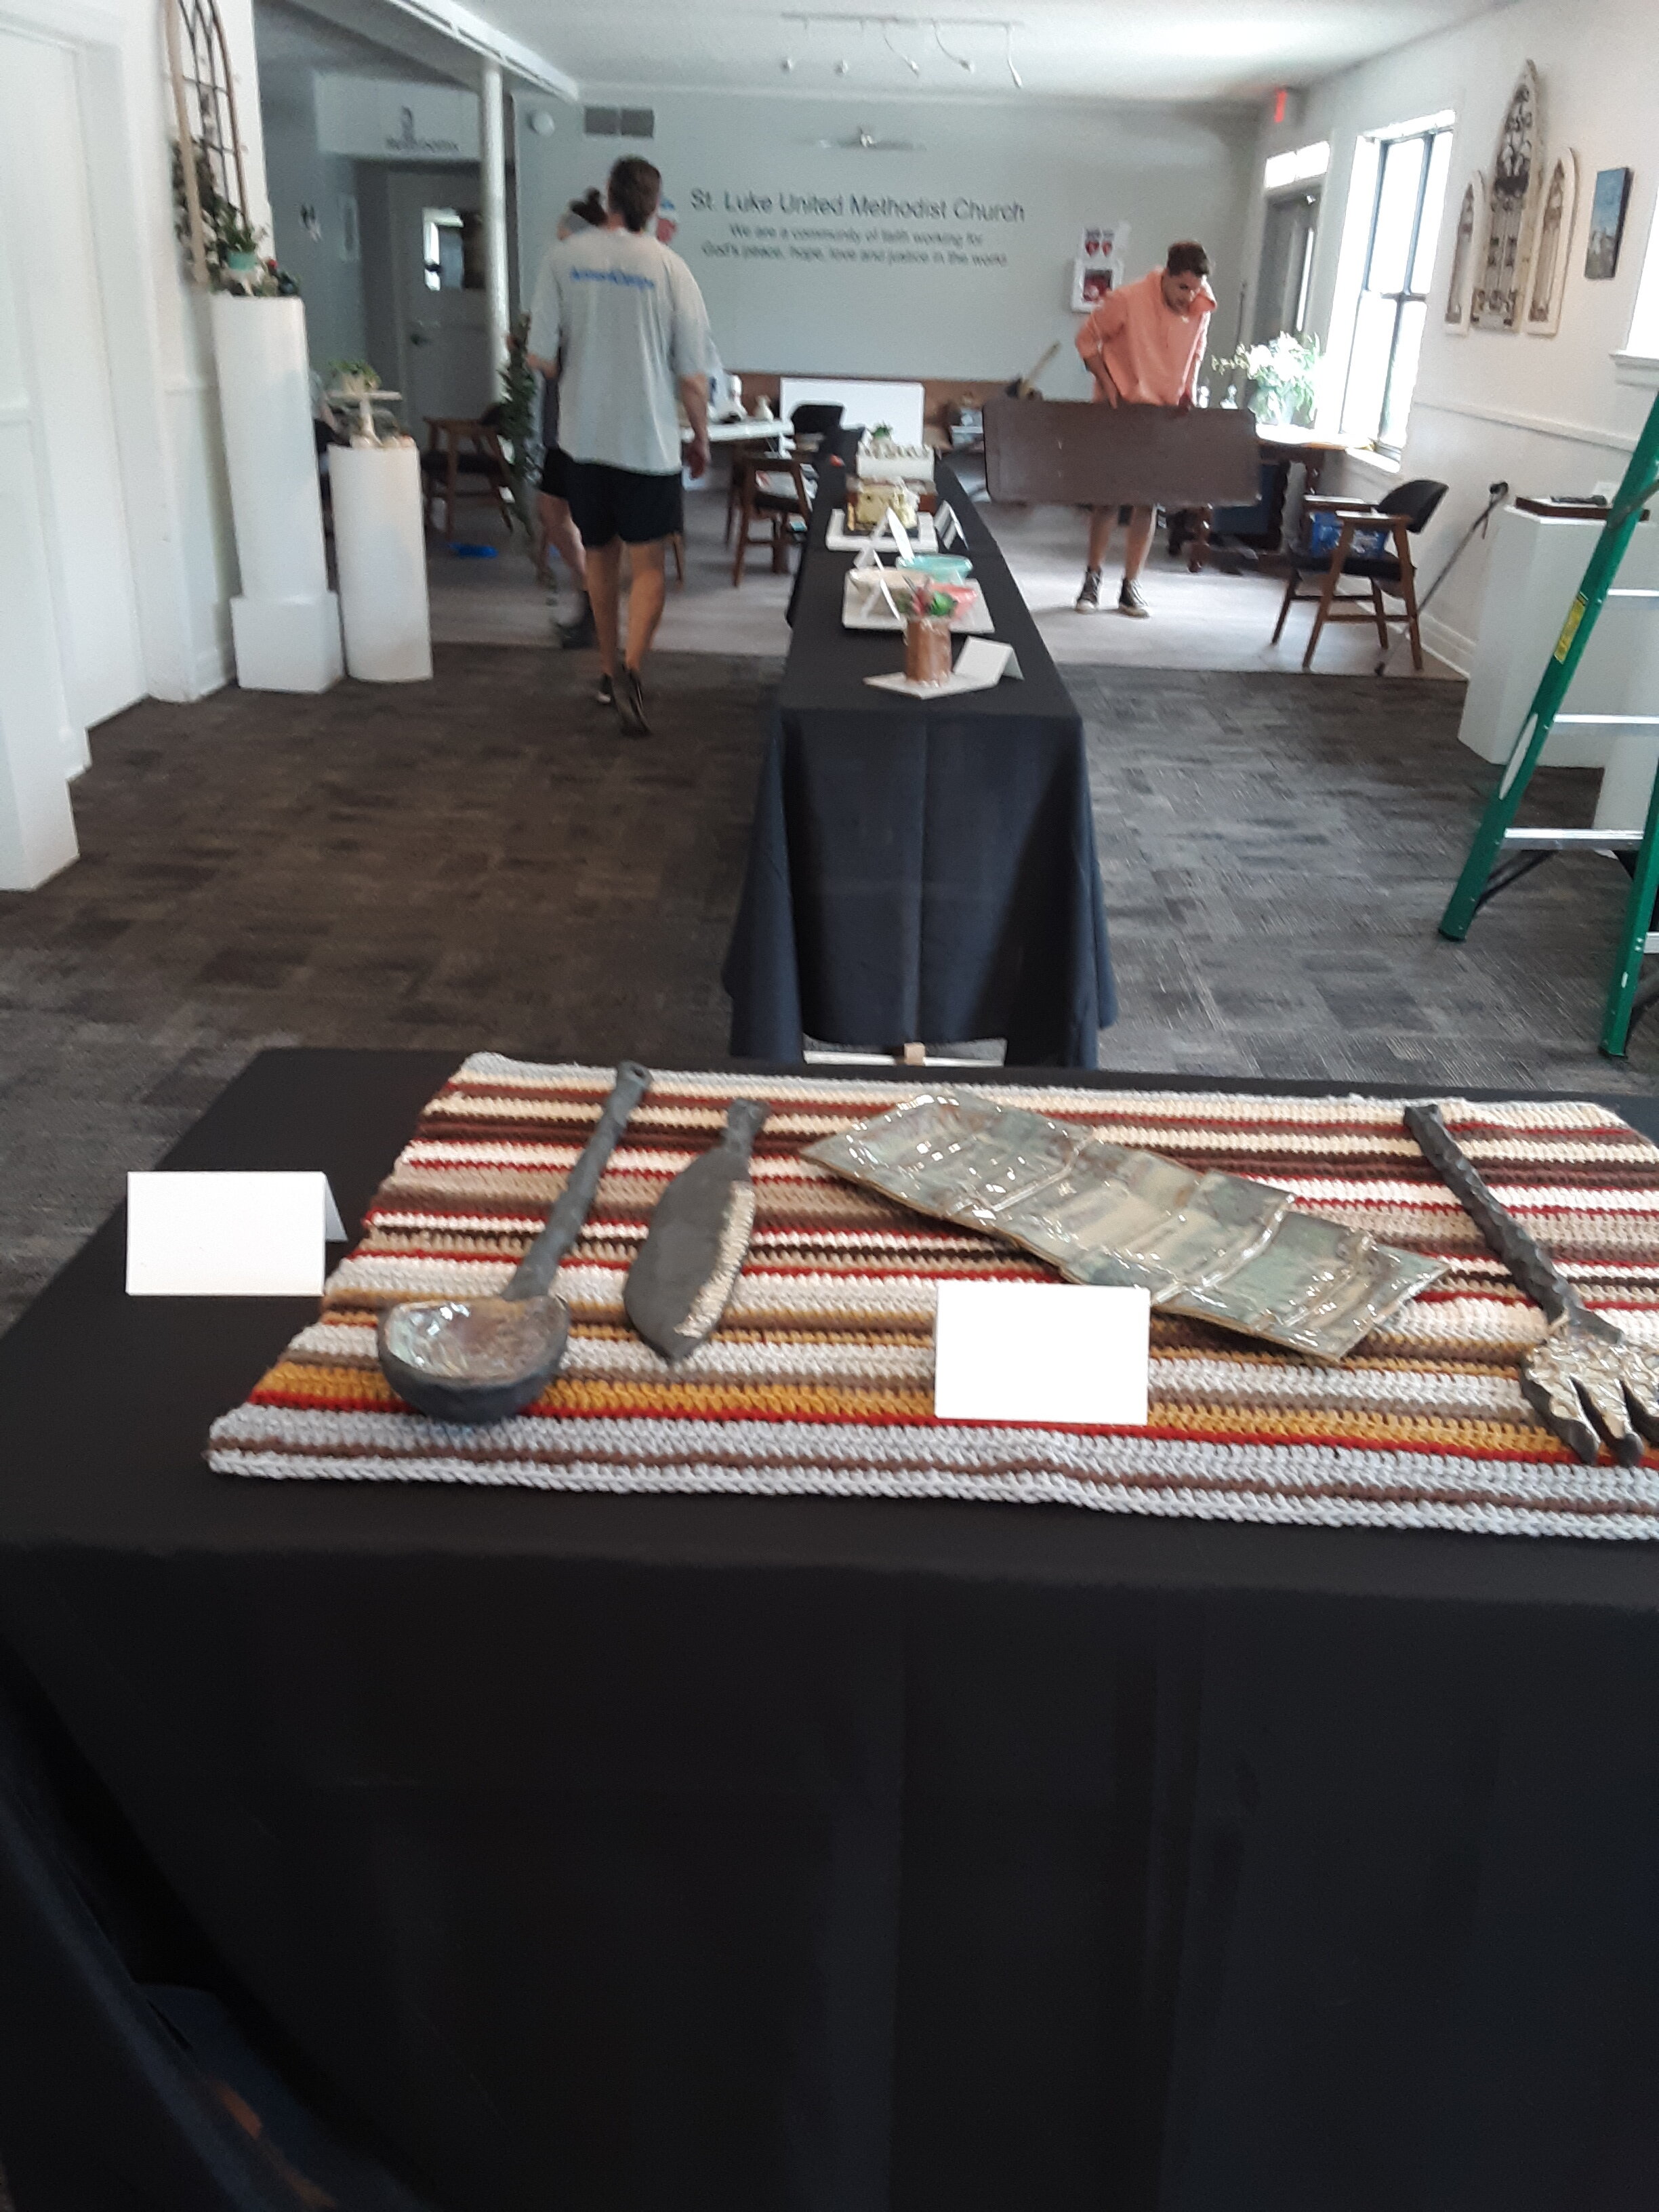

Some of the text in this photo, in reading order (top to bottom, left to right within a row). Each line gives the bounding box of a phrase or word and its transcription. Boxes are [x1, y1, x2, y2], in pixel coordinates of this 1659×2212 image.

[723, 189, 773, 215] Luke
[779, 192, 843, 217] United
[848, 193, 947, 220] Methodist
[954, 198, 1025, 223] Church
[730, 224, 751, 238] We
[754, 226, 777, 238] are
[792, 228, 860, 245] community
[865, 227, 878, 241] of
[882, 228, 909, 243] faith
[913, 232, 963, 249] working
[966, 232, 983, 247] for
[829, 247, 856, 261] love
[861, 249, 884, 262] and
[888, 249, 929, 265] justice
[933, 251, 945, 264] in
[949, 251, 969, 265] the
